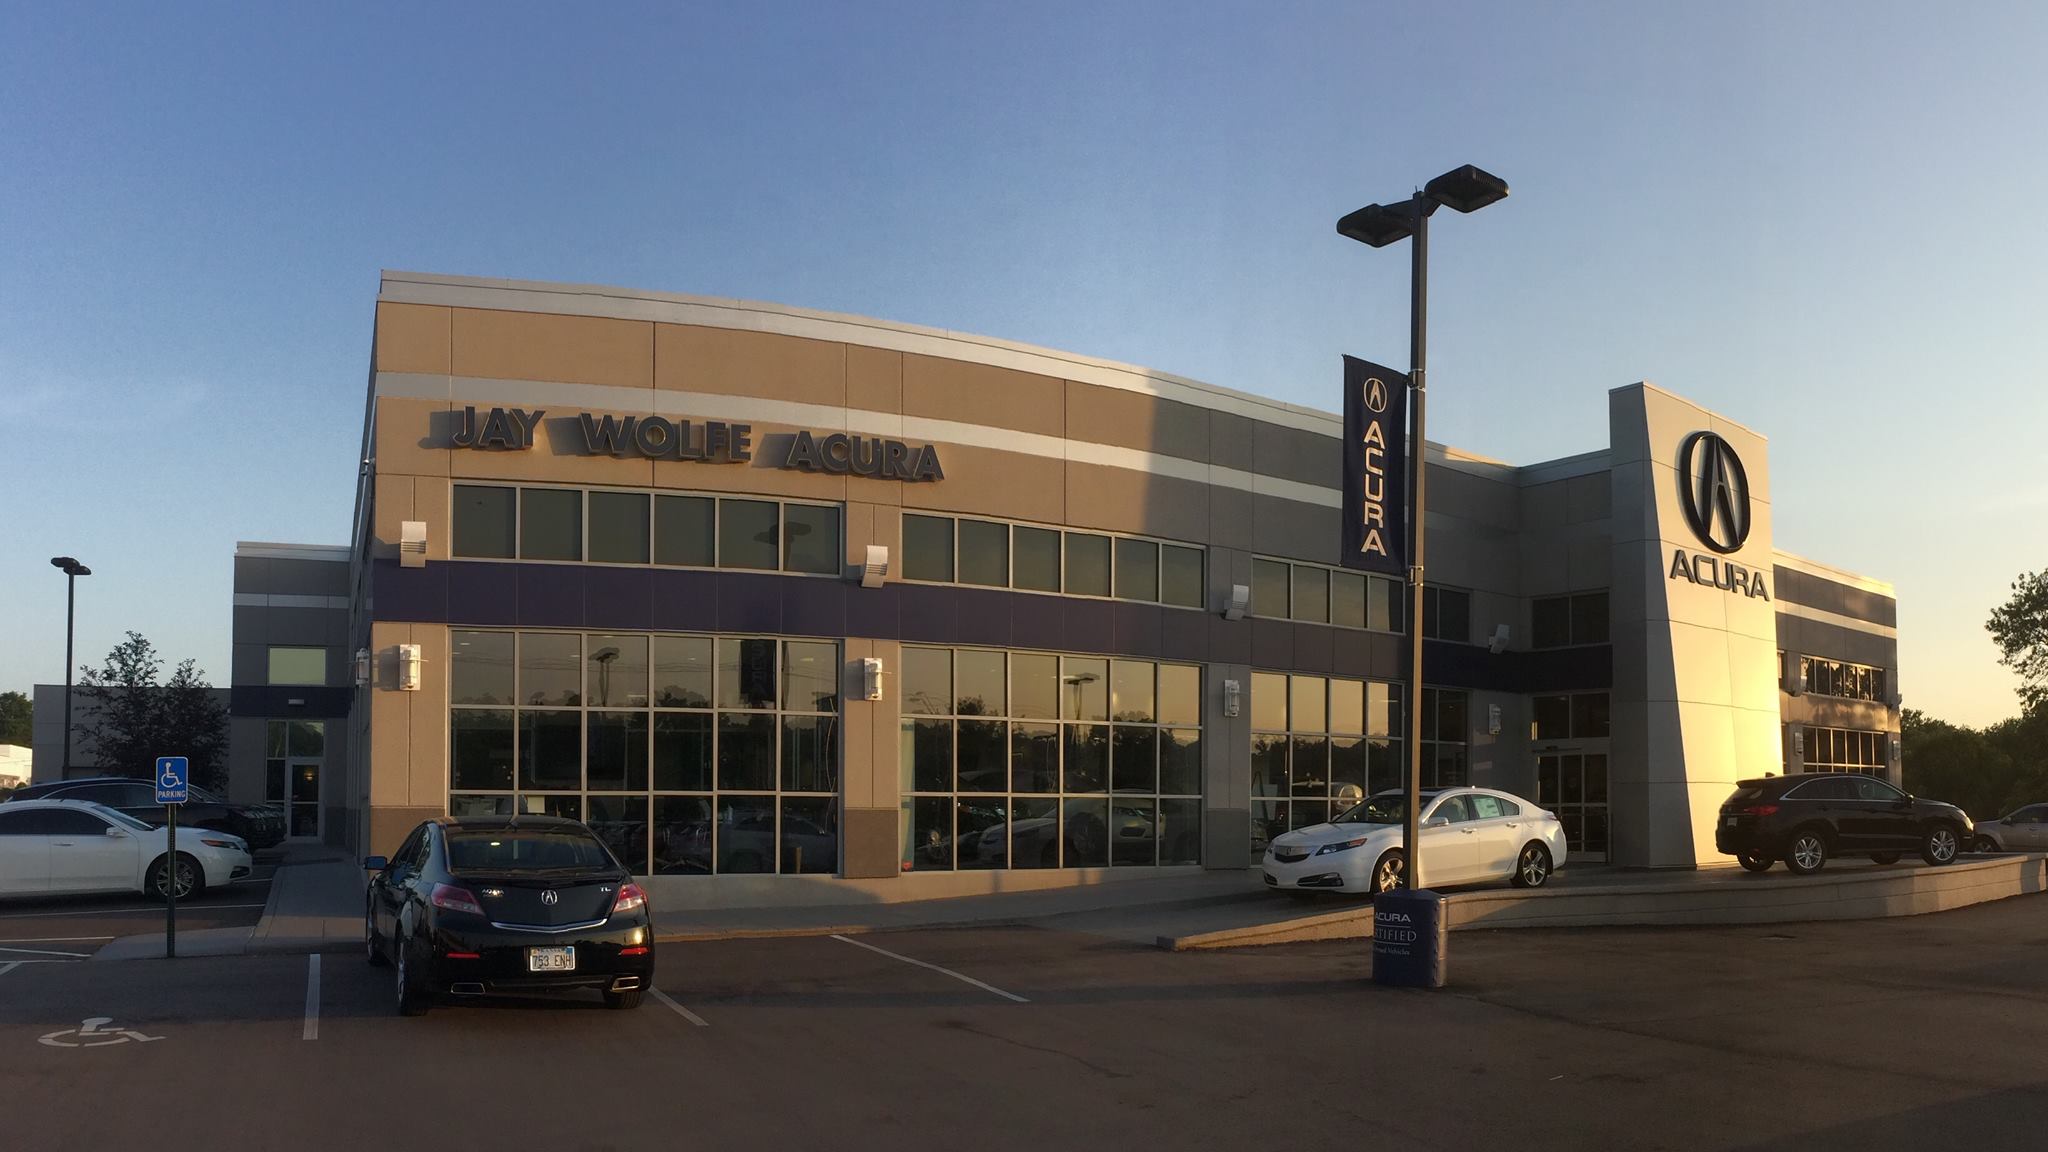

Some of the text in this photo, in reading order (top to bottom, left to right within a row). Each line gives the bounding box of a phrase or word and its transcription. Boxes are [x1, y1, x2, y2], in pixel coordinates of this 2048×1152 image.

[452, 406, 945, 481] JAY WOLFE ACURA
[1361, 420, 1387, 557] ACURA
[1669, 549, 1771, 602] ACURA
[158, 790, 186, 798] PARKING
[533, 955, 550, 967] 753
